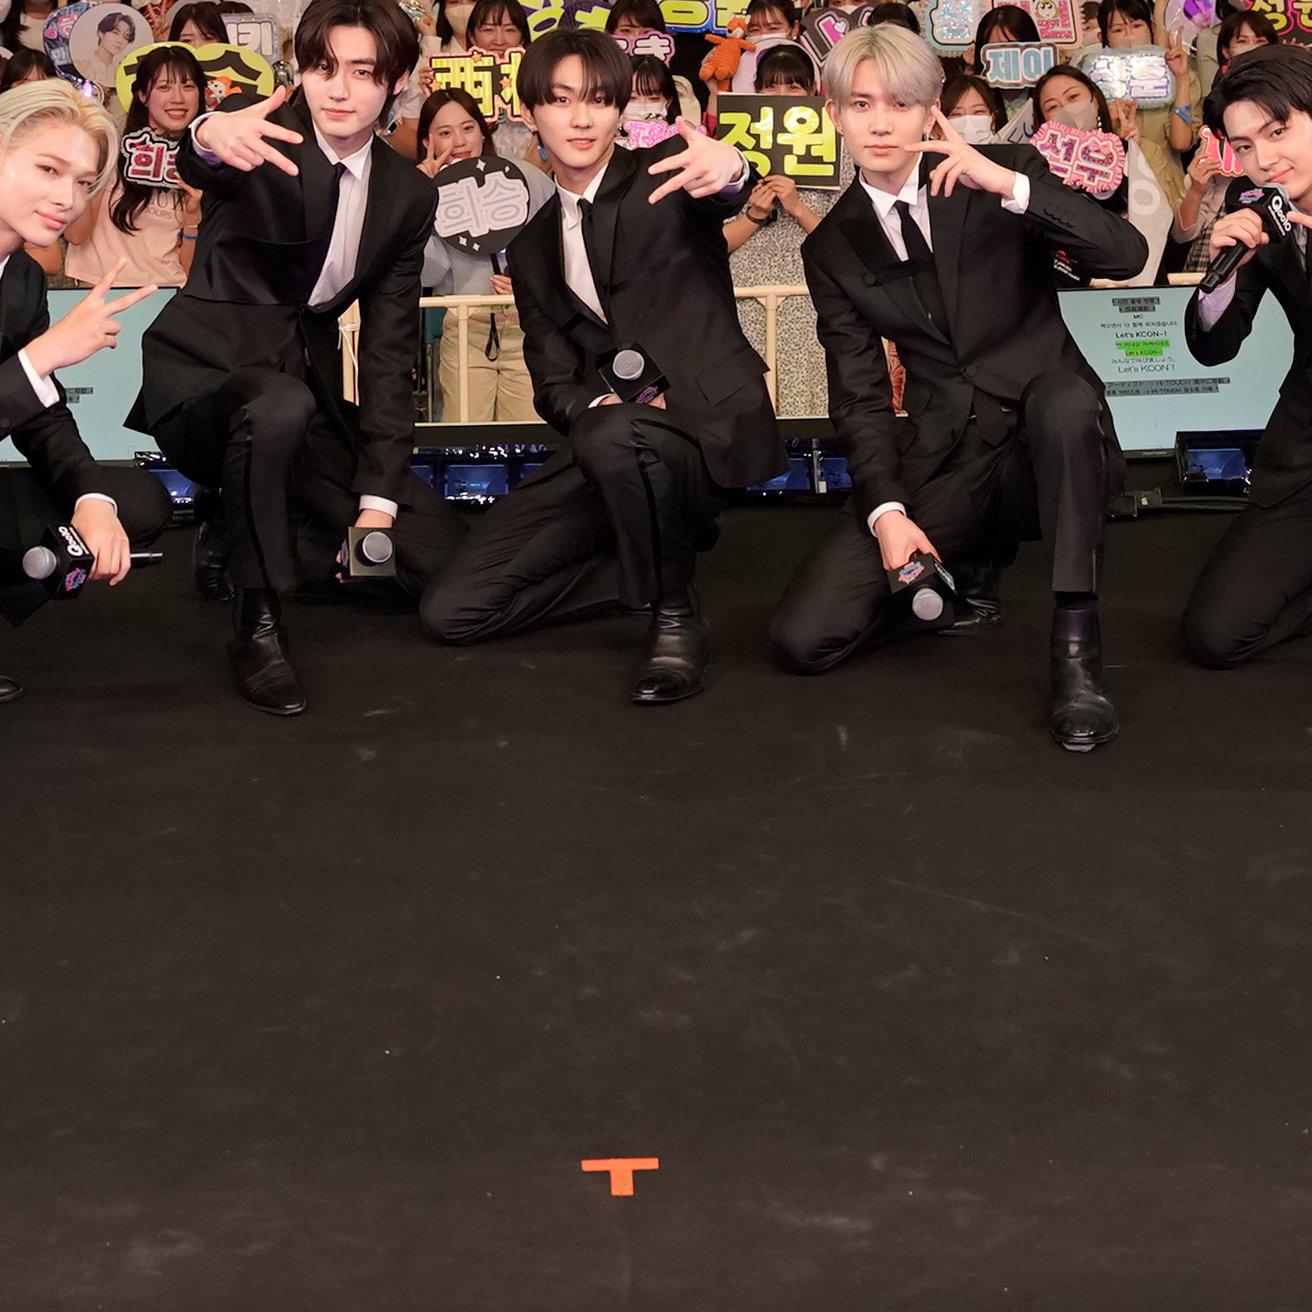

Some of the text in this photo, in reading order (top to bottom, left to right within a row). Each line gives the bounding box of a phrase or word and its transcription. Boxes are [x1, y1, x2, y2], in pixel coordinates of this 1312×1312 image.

[988, 47, 1053, 83] 제이
[716, 105, 839, 180] 정원
[1038, 133, 1124, 186] 선우
[434, 174, 531, 238] 희승
